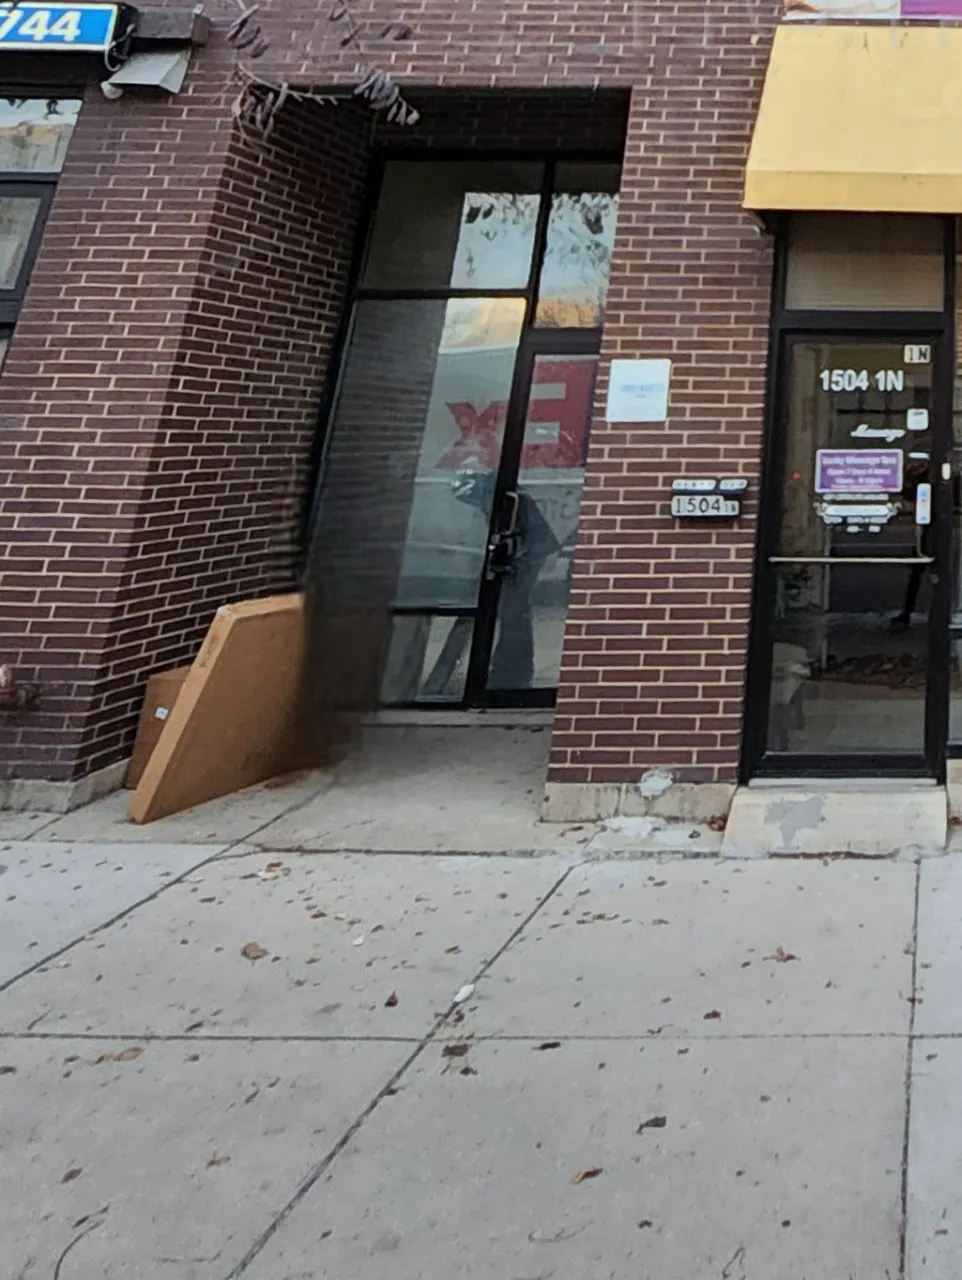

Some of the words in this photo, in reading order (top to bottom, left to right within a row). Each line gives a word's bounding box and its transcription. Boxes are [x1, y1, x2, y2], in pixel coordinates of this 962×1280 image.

[908, 347, 929, 361] 1N
[819, 369, 869, 391] 1504
[875, 369, 904, 391] 1N
[675, 497, 721, 513] 1504
